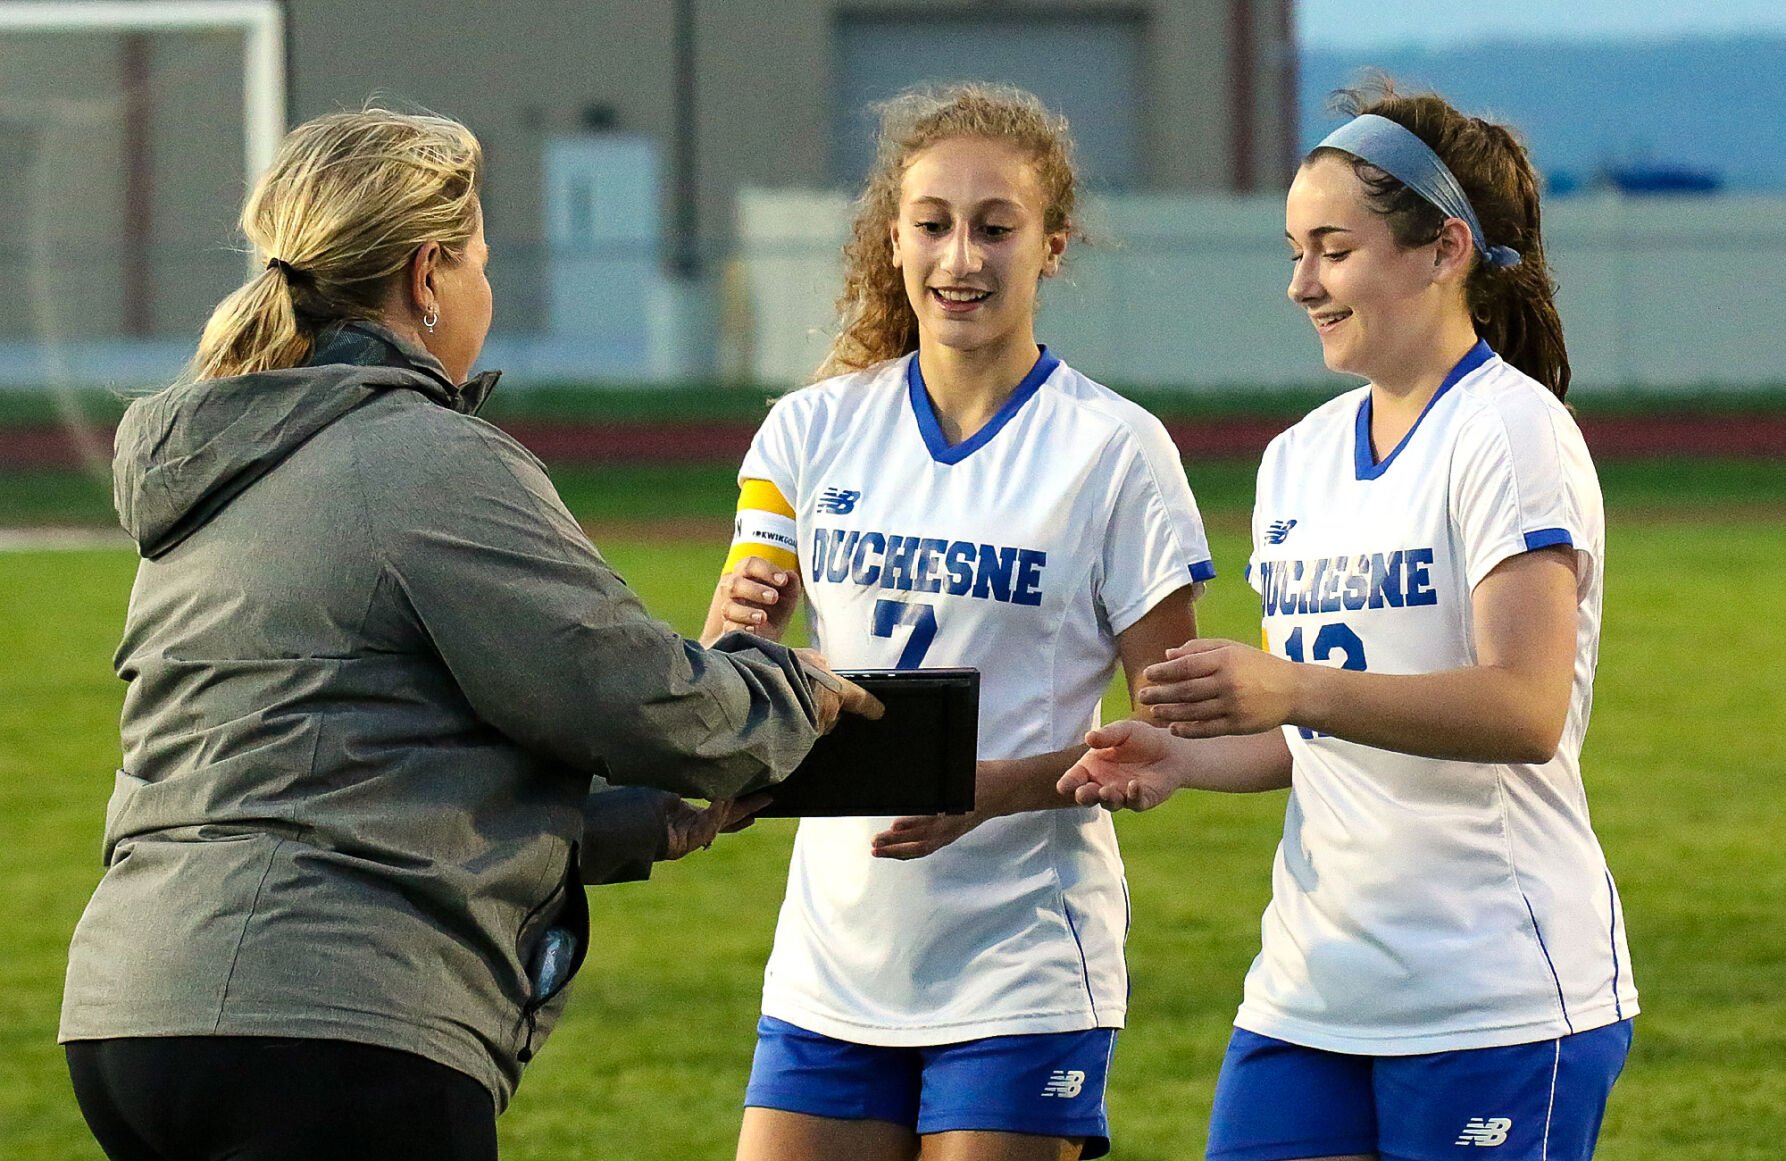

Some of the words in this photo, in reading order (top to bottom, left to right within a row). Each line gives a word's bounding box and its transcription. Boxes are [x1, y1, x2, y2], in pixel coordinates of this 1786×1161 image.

[761, 531, 797, 549] KWIKGOA
[812, 528, 1047, 606] DUCHESNE
[871, 599, 938, 669] 7
[1041, 1070, 1085, 1098] NB
[1454, 1117, 1512, 1147] NB
